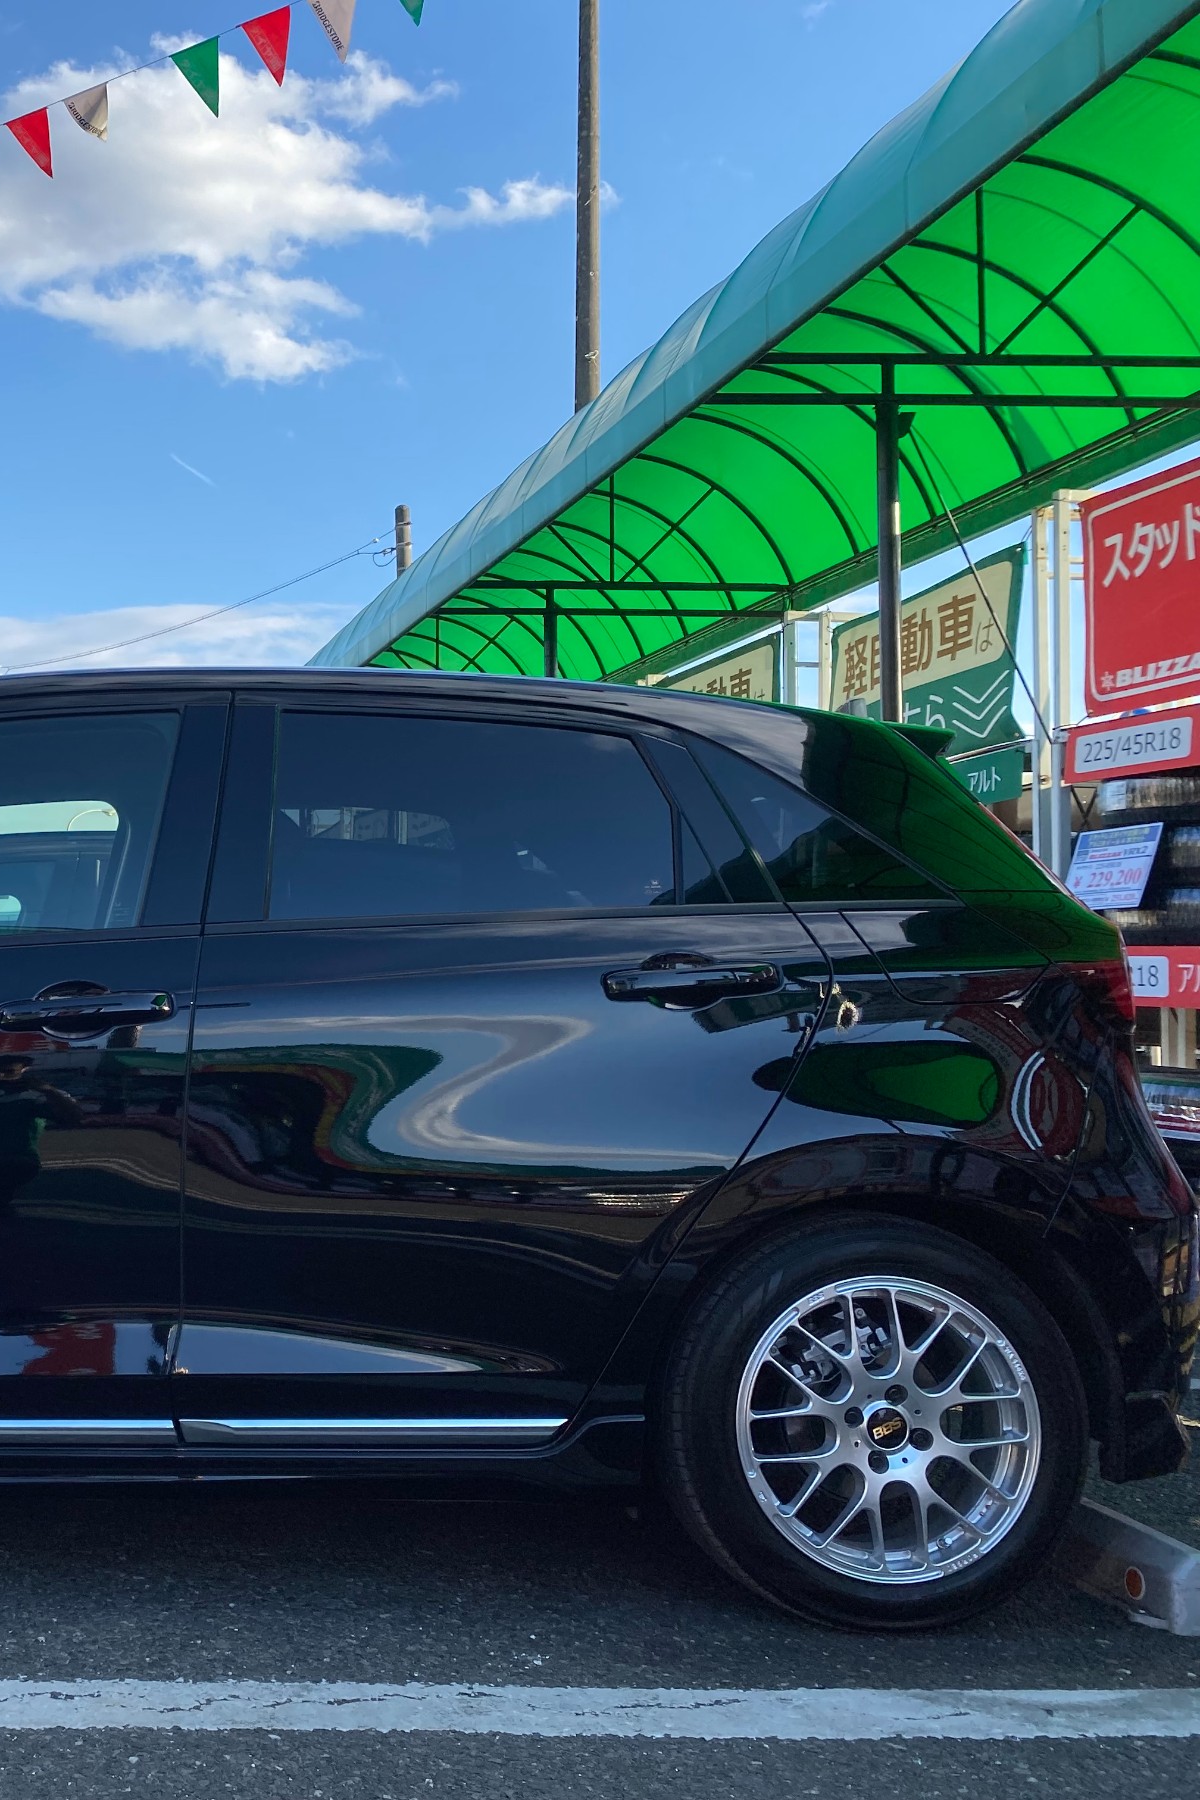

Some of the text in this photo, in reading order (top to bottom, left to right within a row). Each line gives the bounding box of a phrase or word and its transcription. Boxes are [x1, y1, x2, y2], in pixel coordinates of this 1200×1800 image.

[312, 1, 345, 52] BRIDGESTONE
[1082, 727, 1182, 764] 225/45R18
[967, 767, 1001, 794] アルト
[1130, 964, 1160, 987] 18
[872, 1417, 903, 1440] BBS
